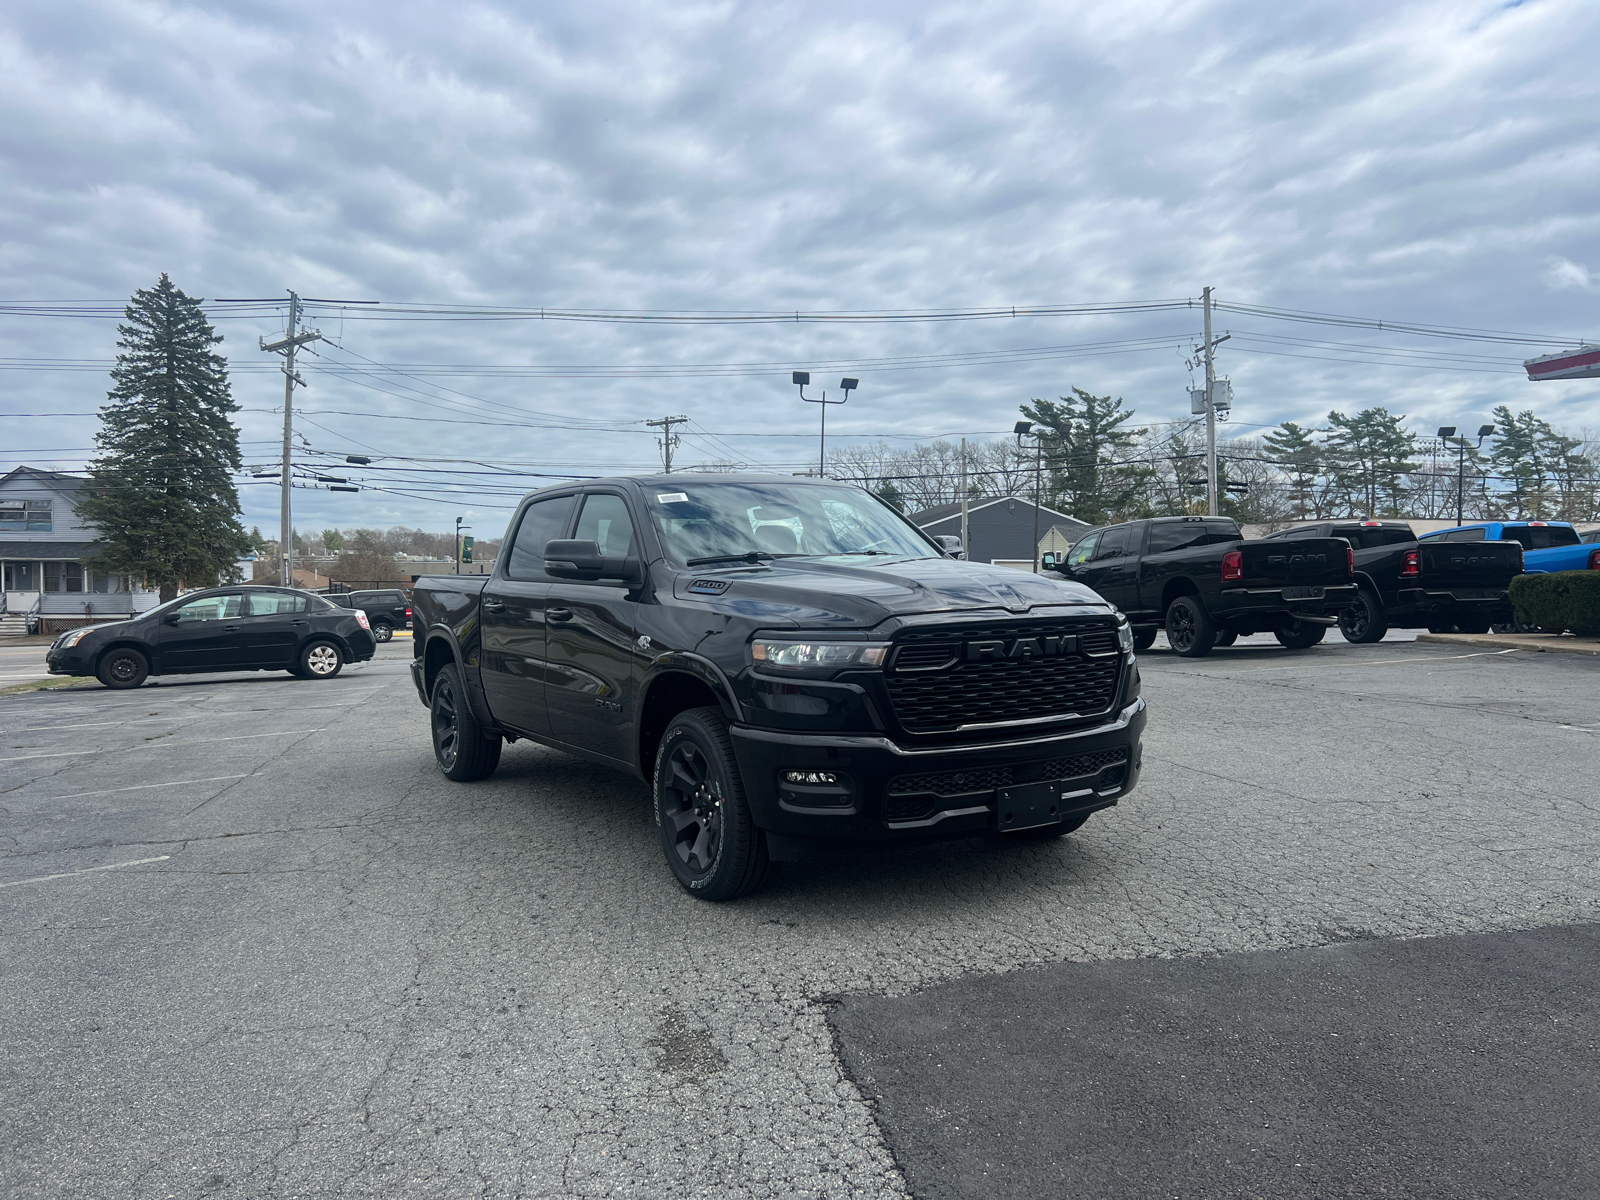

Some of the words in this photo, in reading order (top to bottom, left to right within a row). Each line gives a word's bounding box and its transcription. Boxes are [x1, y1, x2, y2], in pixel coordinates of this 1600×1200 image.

[1267, 553, 1327, 565] RAM
[1450, 556, 1497, 566] RAM
[695, 580, 725, 590] 1500
[967, 634, 1078, 660] RAM
[595, 698, 624, 713] RAM
